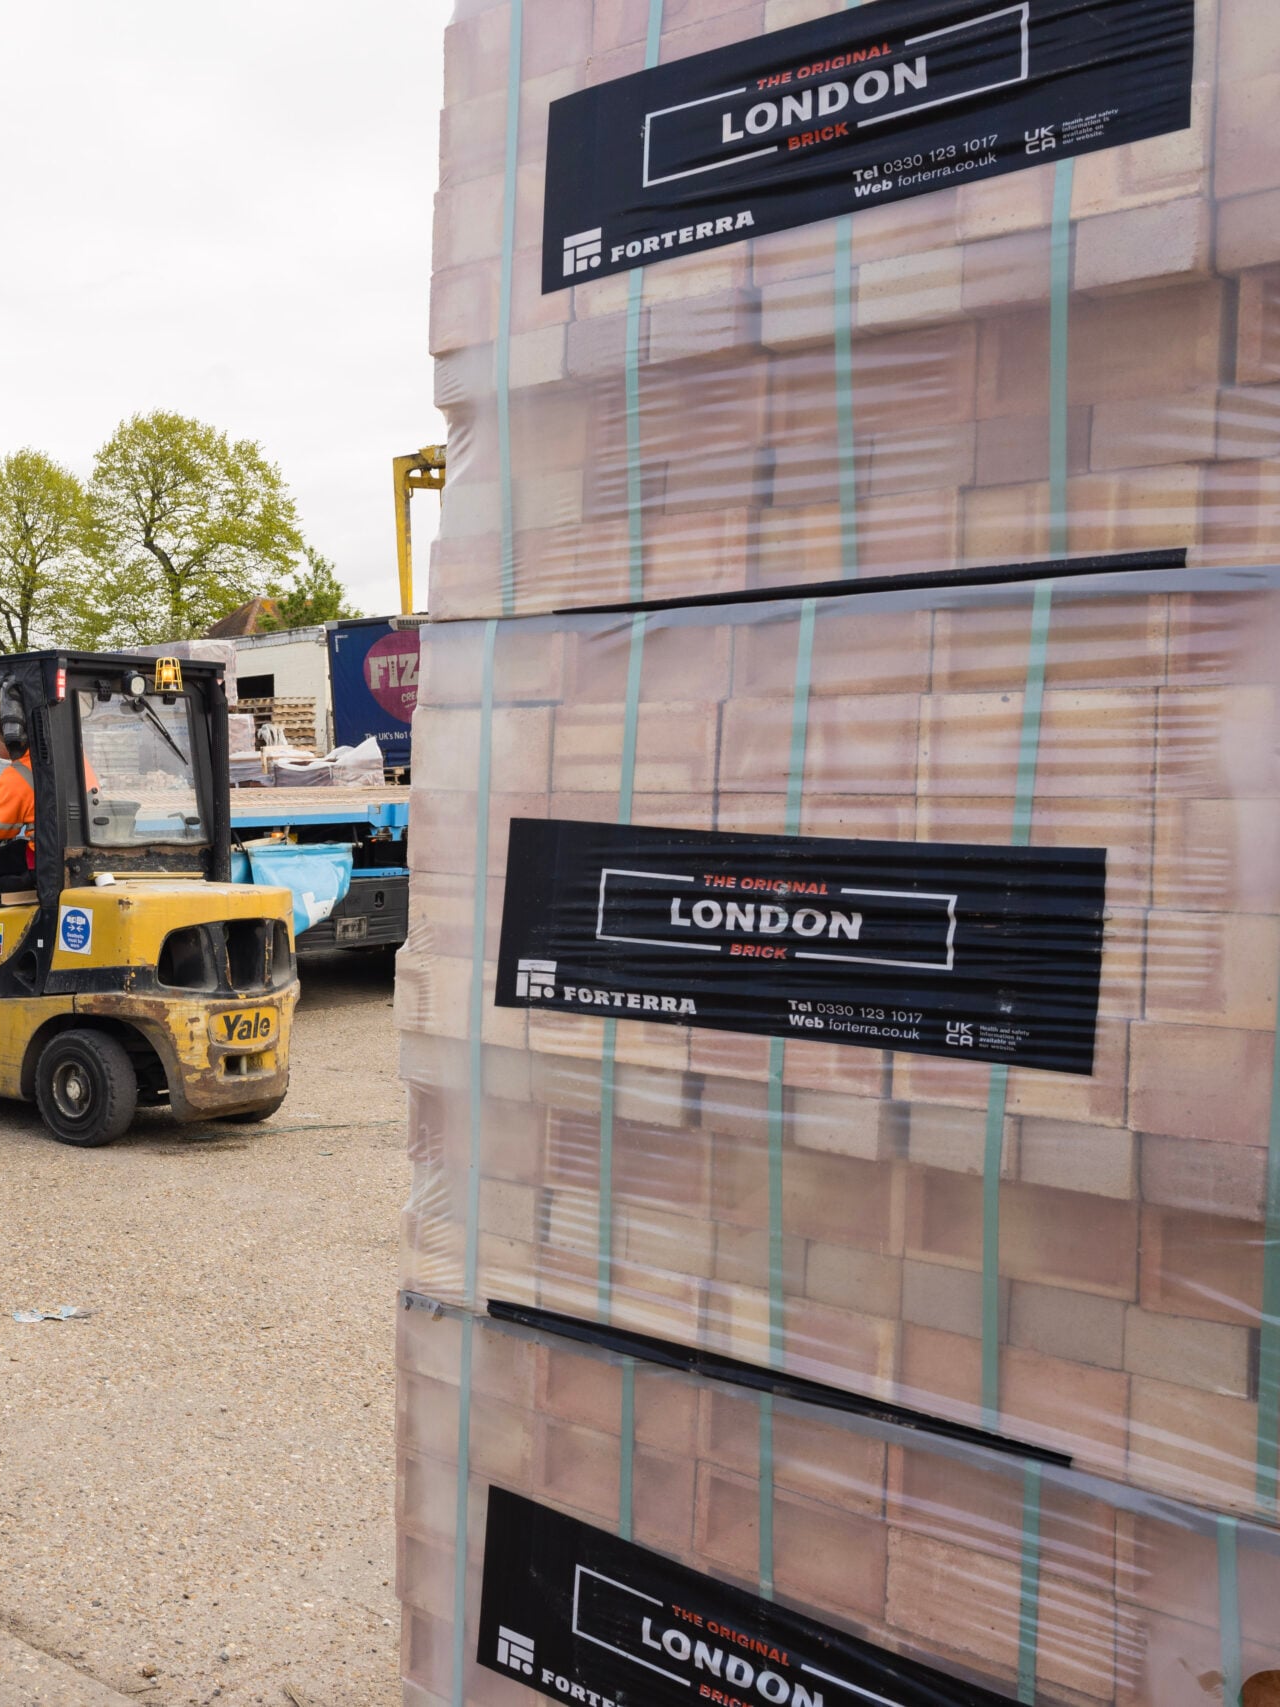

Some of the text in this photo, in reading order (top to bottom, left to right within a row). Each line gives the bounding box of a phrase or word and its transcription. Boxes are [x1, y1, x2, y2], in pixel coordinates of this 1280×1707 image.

[757, 42, 892, 90] THE ORIGINAL
[722, 56, 928, 143] LONDON
[1062, 118, 1101, 133] information
[1063, 108, 1119, 127] Health and safety
[788, 122, 849, 150] BRICK
[1025, 124, 1054, 142] UK
[1062, 128, 1093, 139] available
[1025, 137, 1056, 154] CA
[852, 134, 998, 182] Tel 0330 123 1017
[854, 152, 998, 197] Web forterra.co.uk
[611, 210, 755, 263] FORTERRA
[401, 690, 417, 703] CRE
[379, 732, 393, 740] UK's
[704, 875, 829, 895] THE ORIGINAL
[670, 897, 863, 940] LONDON
[729, 943, 788, 960] BRICK
[563, 986, 697, 1014] FORTERRA
[788, 1000, 923, 1023] Tel 0330 123 1017
[223, 1012, 270, 1041] Yale
[788, 1014, 920, 1039] Web forterra.co.uk
[946, 1021, 973, 1035] UK
[945, 1033, 973, 1047] CA
[671, 1604, 790, 1667] THE ORIGINAL
[642, 1616, 824, 1707] LONDON
[542, 1668, 624, 1707] FORTE
[699, 1684, 754, 1707] BRIC
